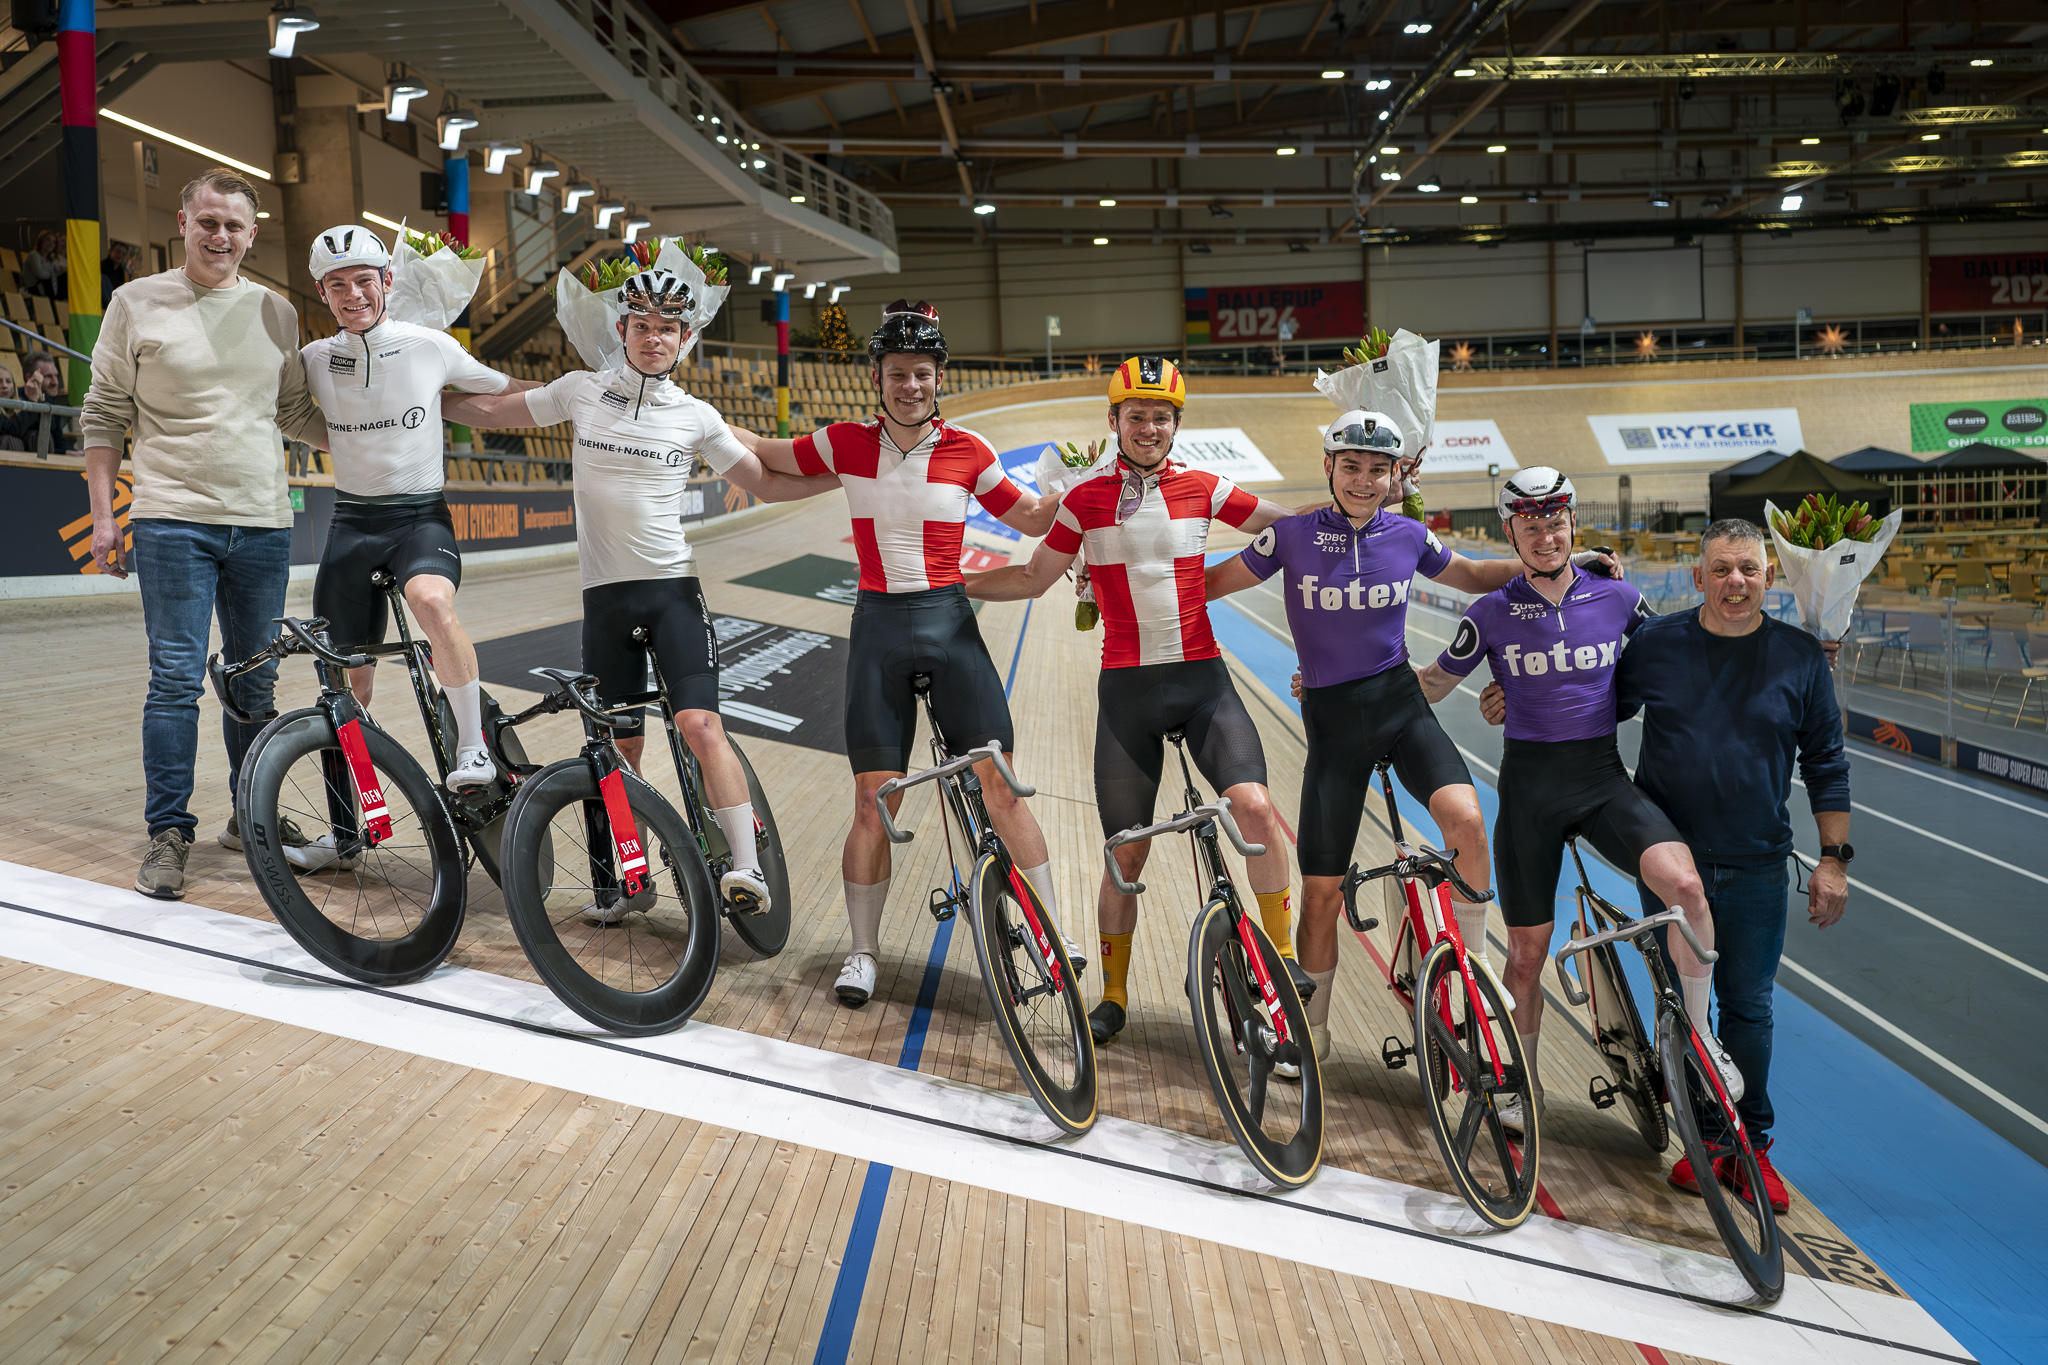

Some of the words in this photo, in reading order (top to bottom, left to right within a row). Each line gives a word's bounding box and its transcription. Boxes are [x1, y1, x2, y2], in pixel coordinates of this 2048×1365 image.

[1217, 289, 1323, 310] BALLERUP
[1217, 306, 1300, 337] 2024
[1656, 422, 1774, 440] RYTGER
[1947, 438, 1979, 448] ONE
[1983, 435, 2021, 446] STOP
[1321, 545, 1347, 553] 2023
[1297, 574, 1411, 611] føtex
[1520, 612, 1548, 620] 2023
[1503, 639, 1618, 676] føtex
[1978, 751, 2009, 777] BALLERUP
[2009, 760, 2032, 784] SUPER
[362, 789, 383, 804] DEN
[620, 838, 640, 855] DEN
[253, 821, 270, 851] DT
[262, 856, 295, 906] SWISS
[1792, 1232, 1902, 1297] 250
